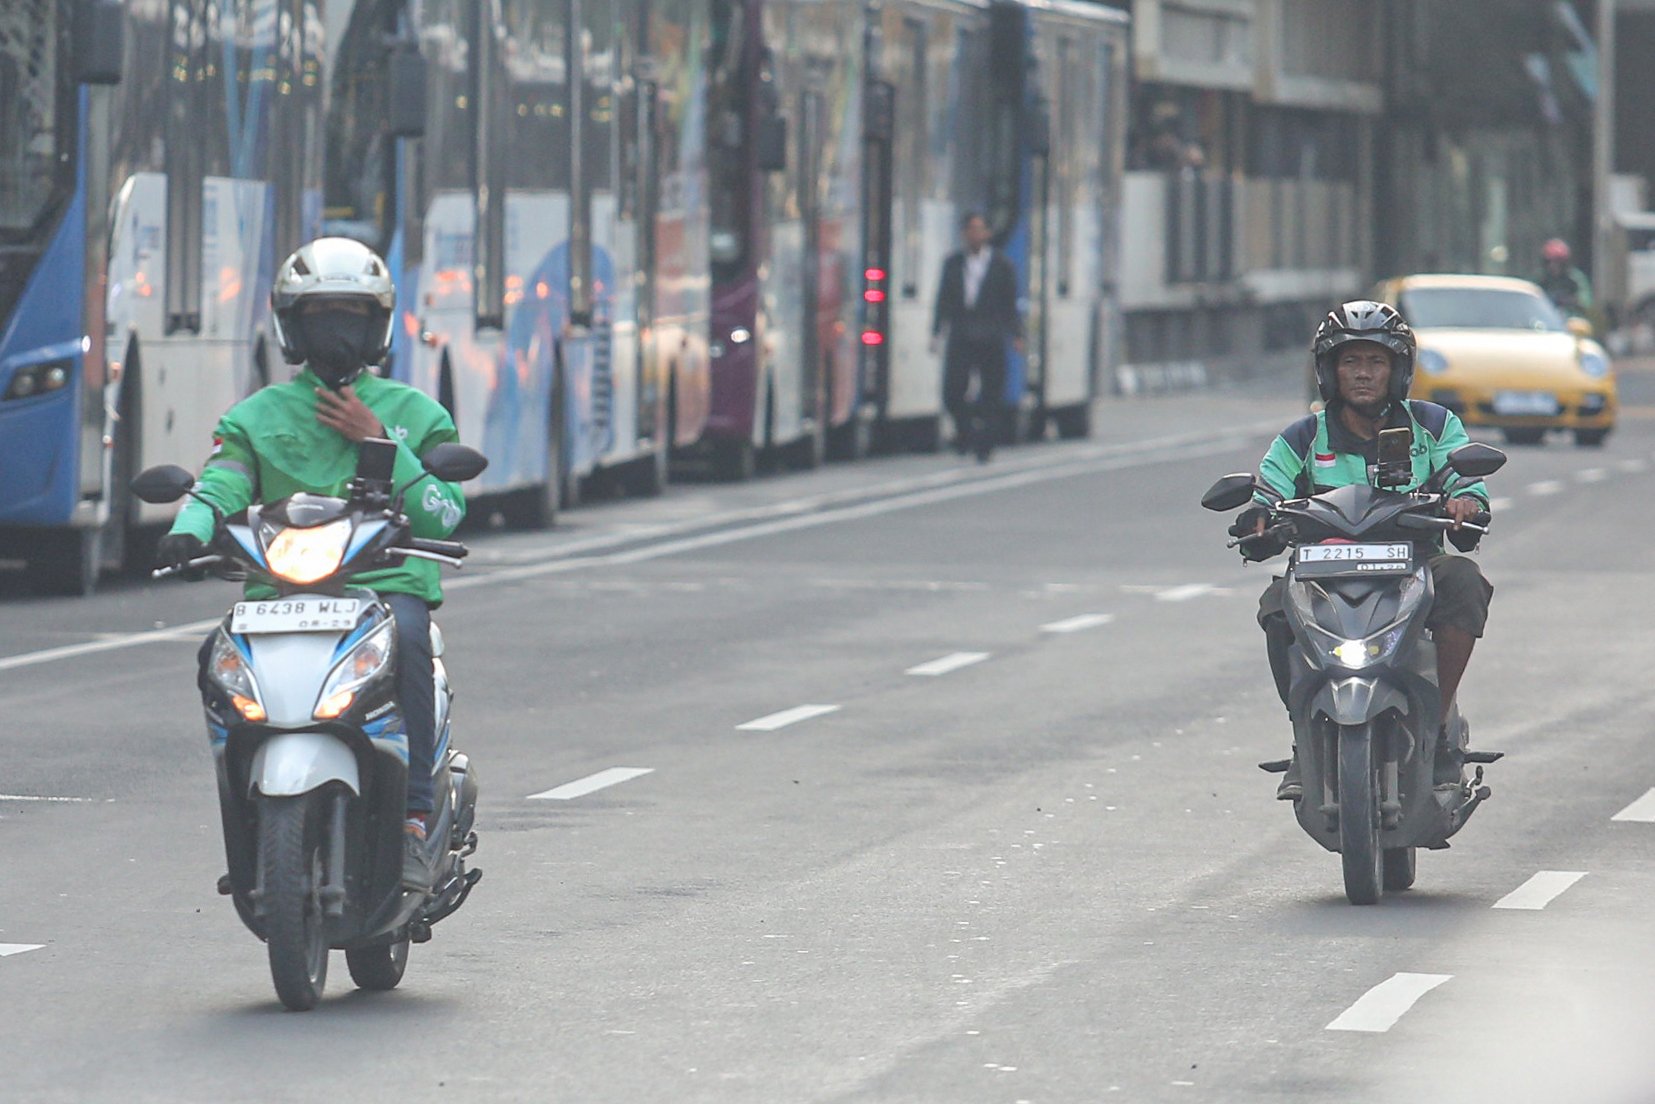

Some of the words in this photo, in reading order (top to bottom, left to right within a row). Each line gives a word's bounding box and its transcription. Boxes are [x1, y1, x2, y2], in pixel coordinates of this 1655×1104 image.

[1410, 442, 1428, 457] ab
[1303, 548, 1312, 560] T
[1323, 547, 1364, 559] 2215
[1387, 546, 1406, 558] SH
[235, 604, 246, 617] B
[256, 602, 306, 616] 6438
[318, 601, 357, 613] WLJ
